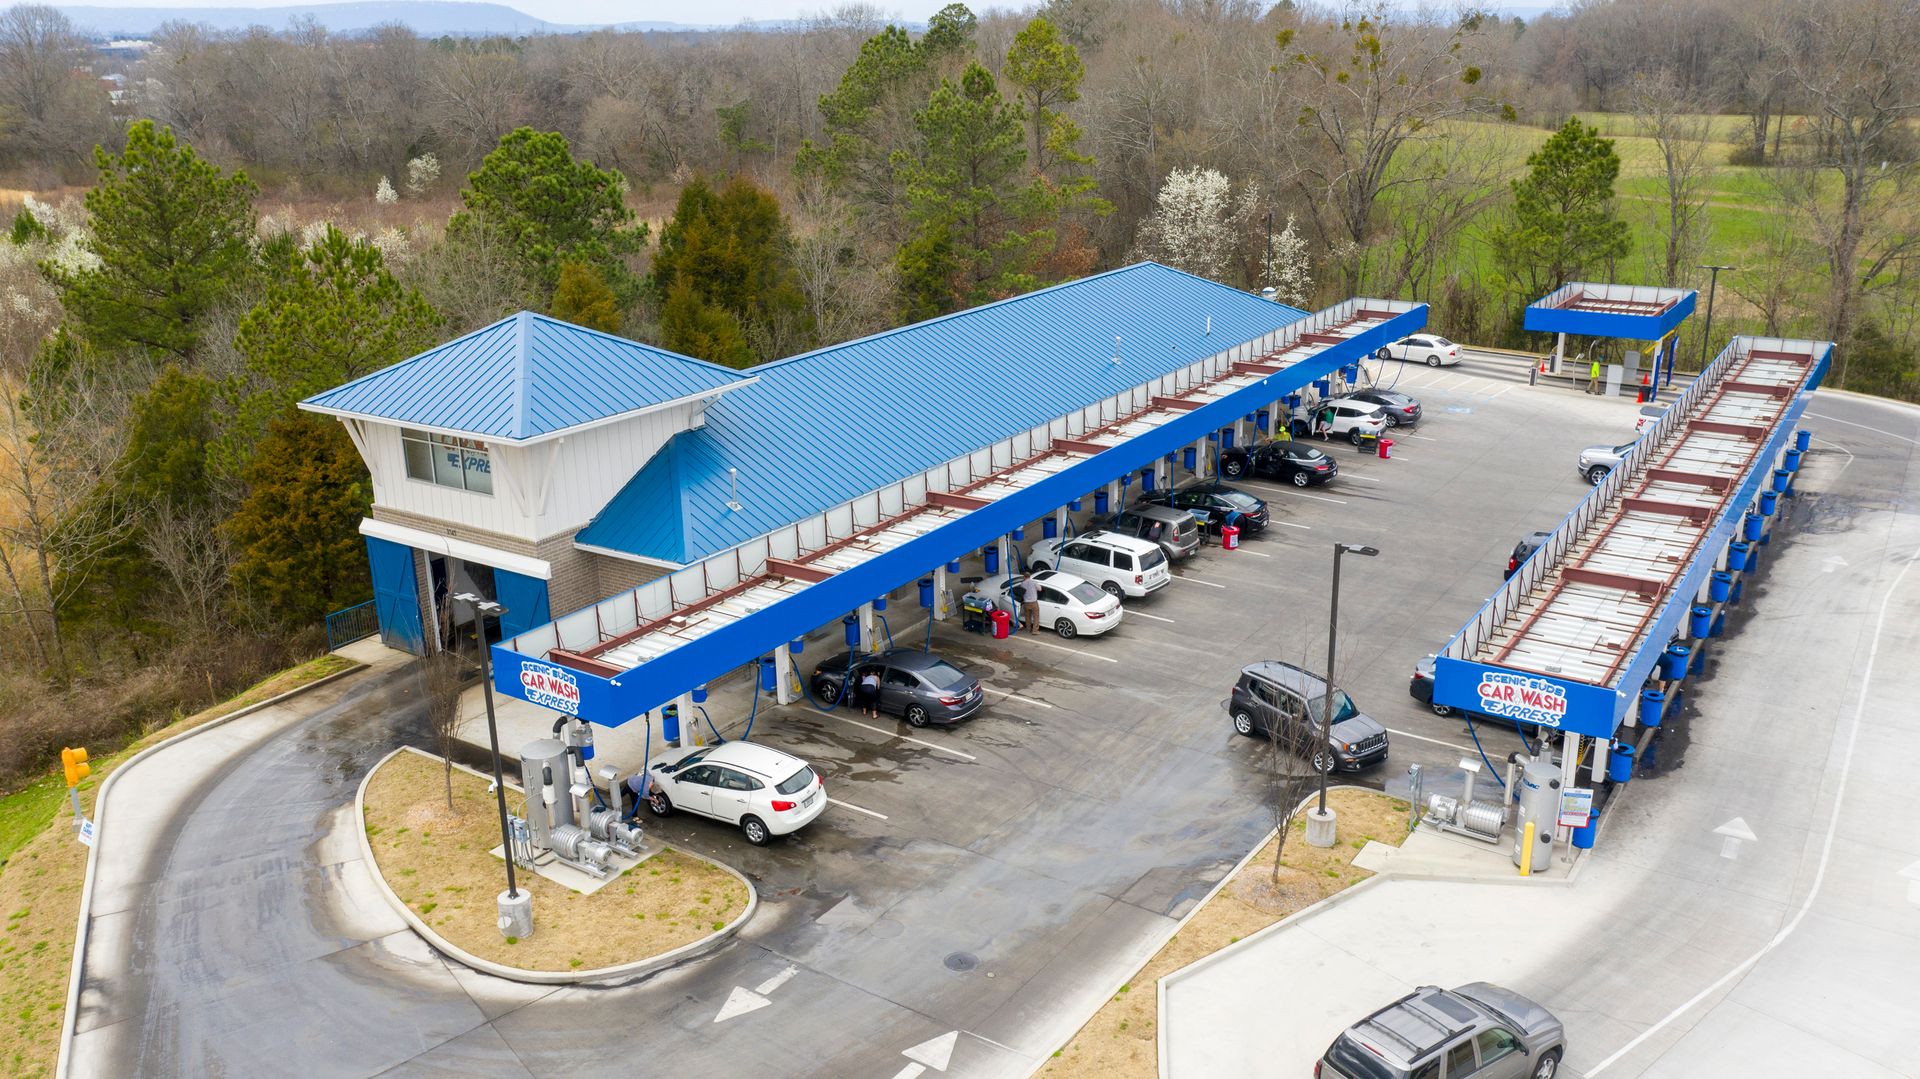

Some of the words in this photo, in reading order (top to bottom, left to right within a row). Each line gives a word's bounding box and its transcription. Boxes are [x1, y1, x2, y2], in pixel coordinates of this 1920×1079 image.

[523, 663, 550, 675] SCENIC
[552, 669, 575, 684] SUDS
[1485, 674, 1526, 687] SCENIC
[1529, 681, 1564, 697] SUDS
[521, 672, 545, 691] CAR
[547, 678, 579, 701] WASH
[1479, 683, 1514, 703] CAR
[1520, 688, 1565, 713] WASH
[526, 689, 578, 713] EXPRESS
[1483, 699, 1560, 724] EXPRESS
